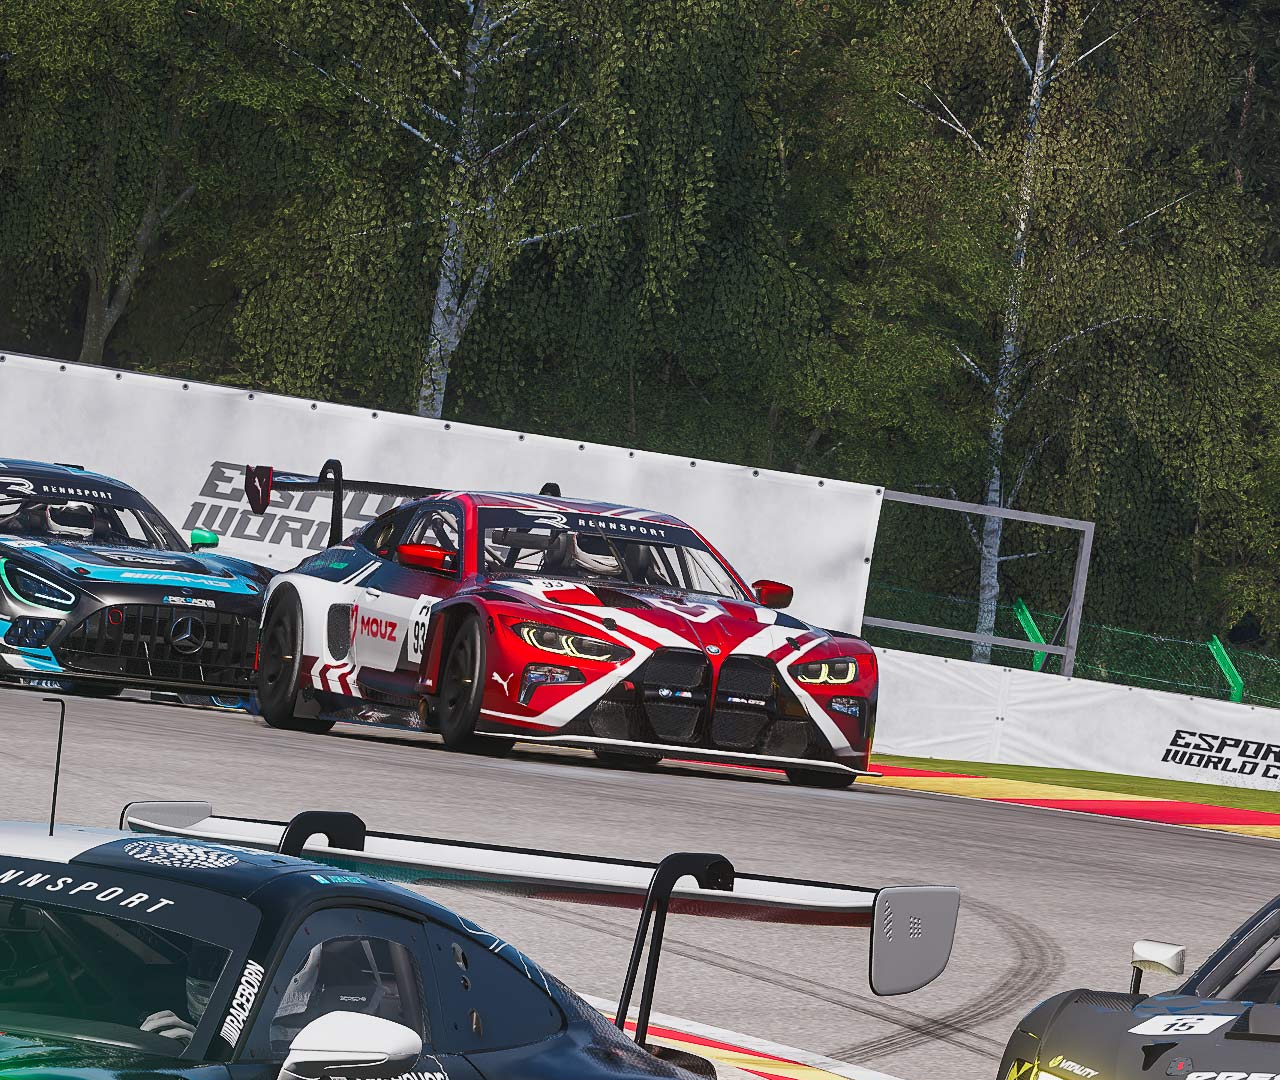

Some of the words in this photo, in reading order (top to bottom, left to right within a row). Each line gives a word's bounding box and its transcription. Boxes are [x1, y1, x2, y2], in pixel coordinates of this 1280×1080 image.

[42, 485, 113, 500] RENNSPORT
[578, 517, 666, 538] RENNSPORT
[360, 615, 398, 642] MOUZ
[413, 620, 426, 654] 93
[1161, 748, 1259, 775] WORLD
[223, 959, 265, 1036] RACEBORN
[1162, 1021, 1196, 1033] 15
[1059, 1059, 1099, 1079] VITALITY
